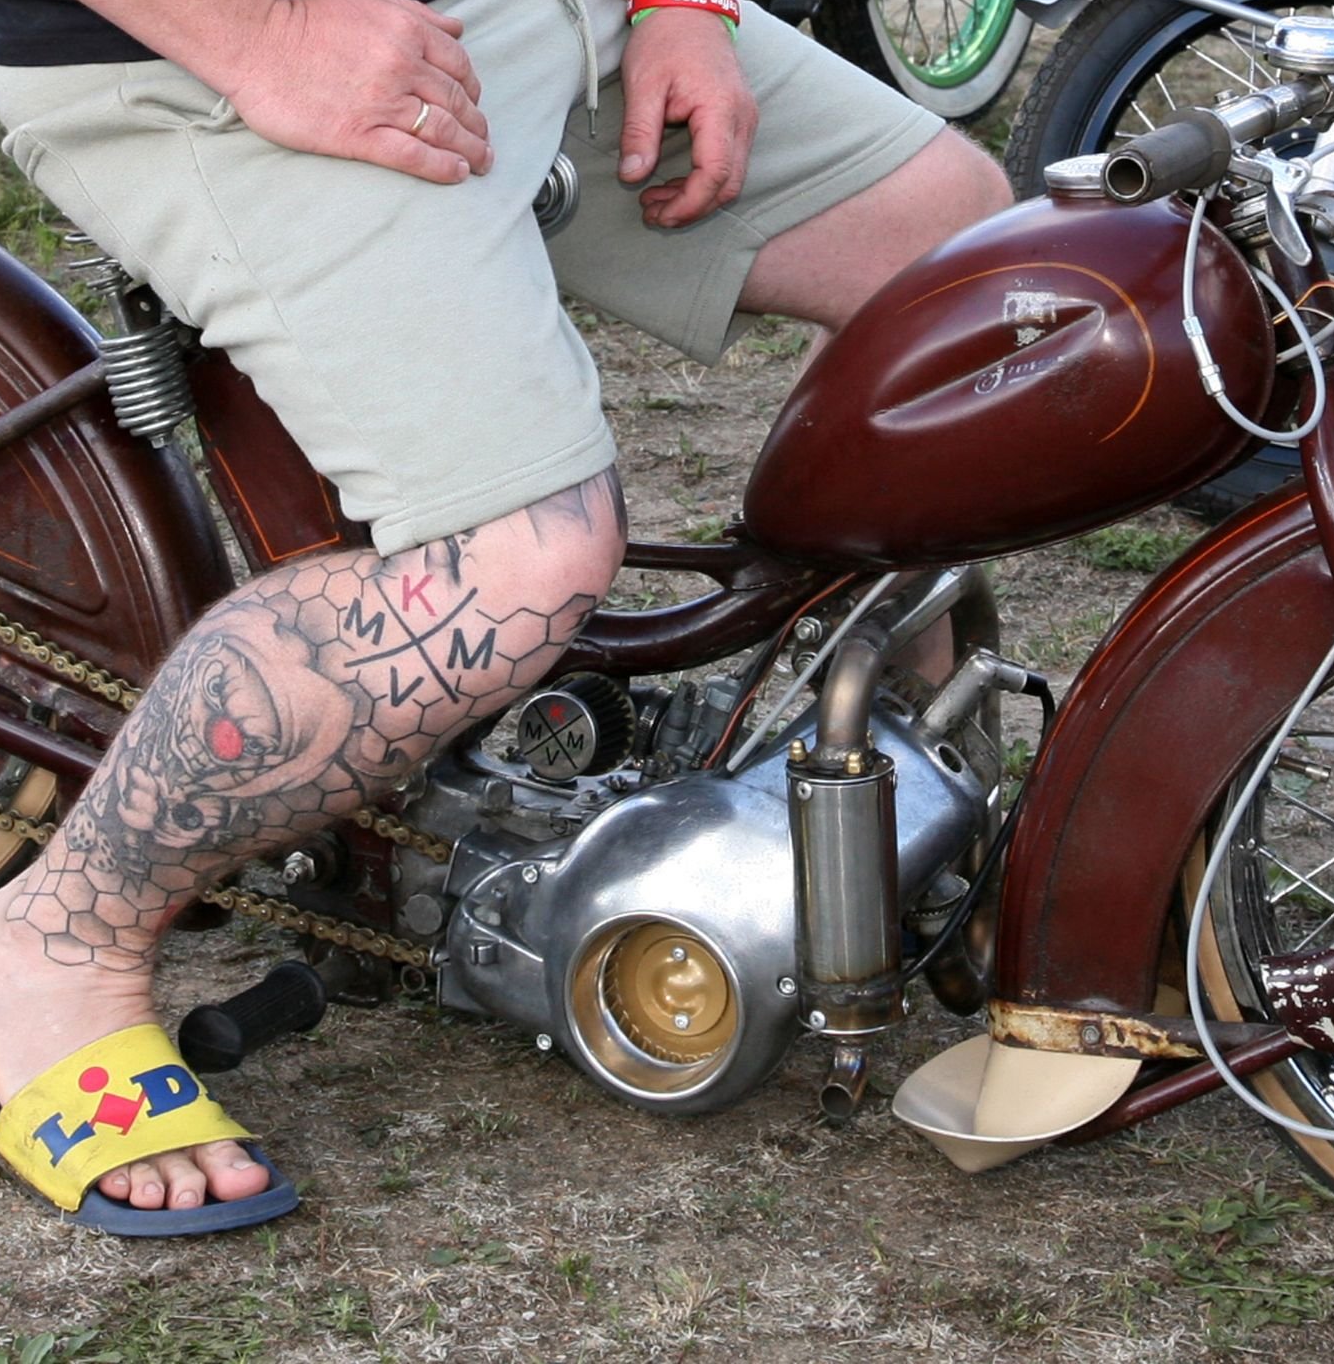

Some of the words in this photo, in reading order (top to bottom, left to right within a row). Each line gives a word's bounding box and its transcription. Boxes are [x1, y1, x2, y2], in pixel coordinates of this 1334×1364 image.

[402, 574, 437, 617] K
[343, 597, 386, 646] M
[447, 628, 497, 670] M
[390, 665, 425, 708] V
[525, 721, 543, 741] M
[567, 730, 585, 751] M
[546, 746, 561, 766] V
